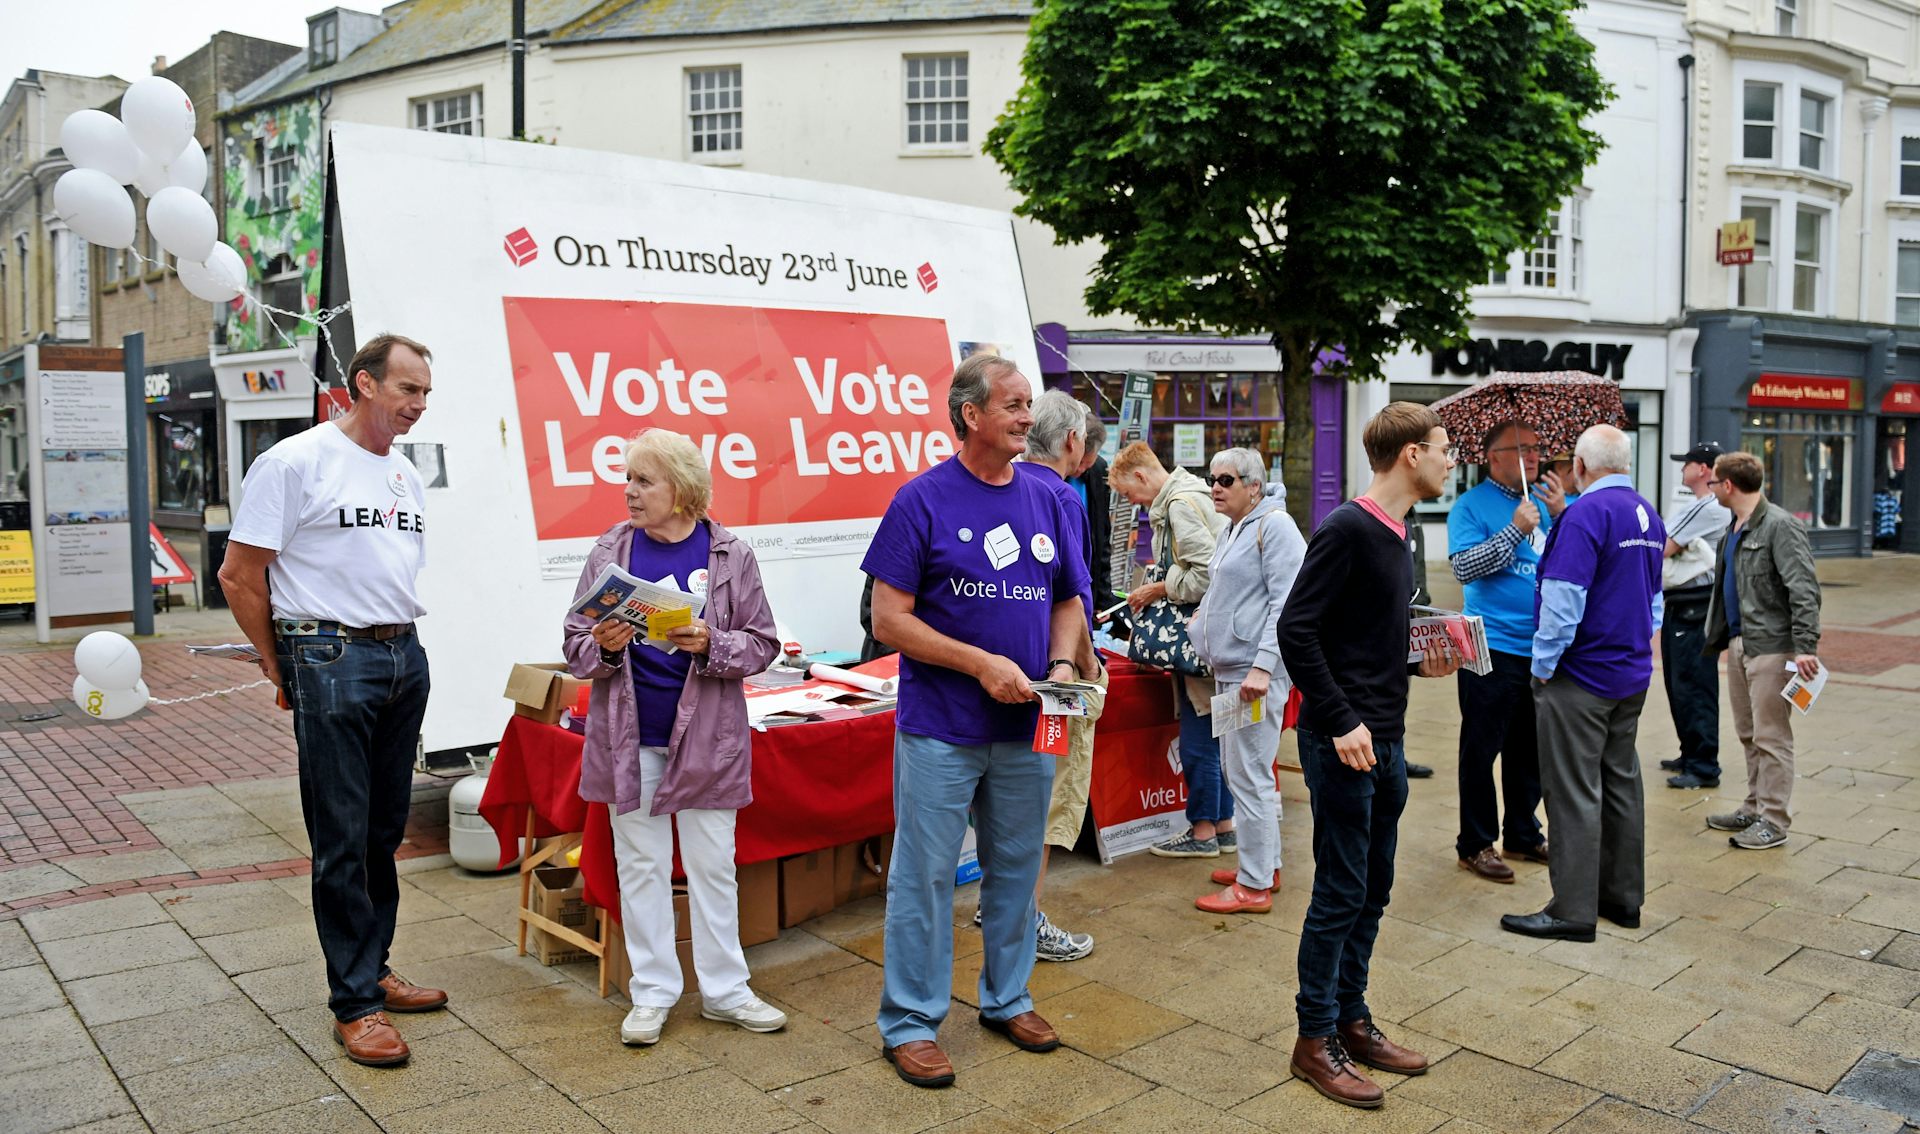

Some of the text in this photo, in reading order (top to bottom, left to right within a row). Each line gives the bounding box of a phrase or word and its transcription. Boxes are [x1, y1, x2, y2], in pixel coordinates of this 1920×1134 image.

[553, 235, 909, 292] On Thursday 23rd June
[552, 352, 728, 416] Vote
[792, 357, 930, 415] Vote
[544, 420, 757, 487] Leve
[789, 417, 954, 477] Leave
[339, 501, 426, 534] LEAVE.E
[751, 535, 783, 549] Leave
[950, 577, 1047, 601] Vote Leave
[1410, 623, 1442, 638] ODAY
[1046, 714, 1055, 748] NTROL
[1140, 787, 1176, 810] Vote
